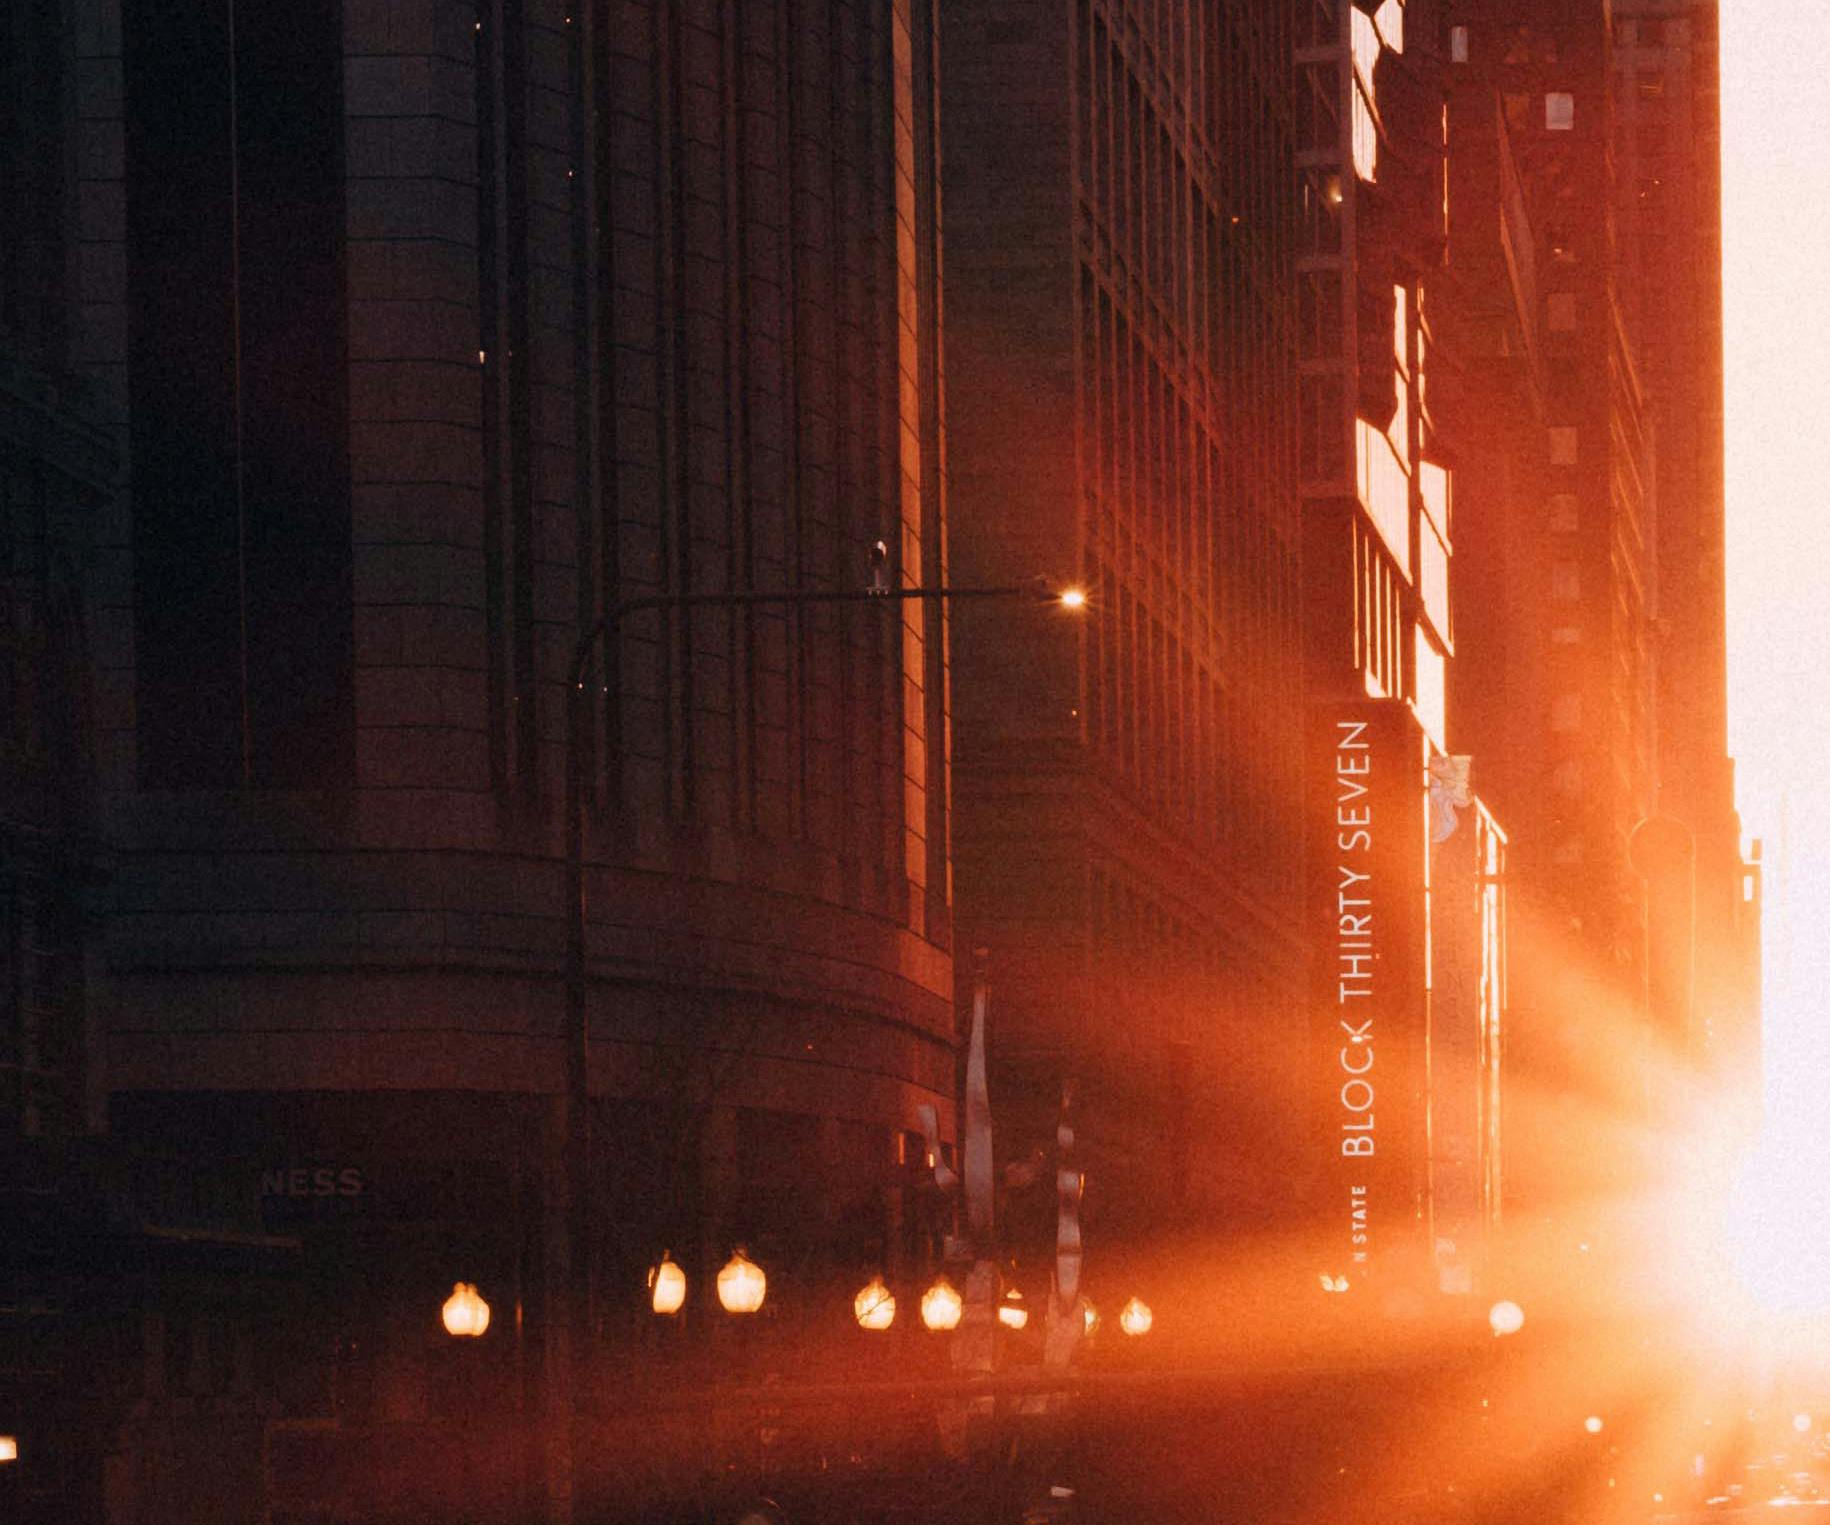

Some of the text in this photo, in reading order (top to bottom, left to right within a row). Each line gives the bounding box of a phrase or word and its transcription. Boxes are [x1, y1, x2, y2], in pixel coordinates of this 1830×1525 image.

[1336, 721, 1375, 1156] BLOCK THIRTY SEVEN
[1351, 1185, 1368, 1244] STATE
